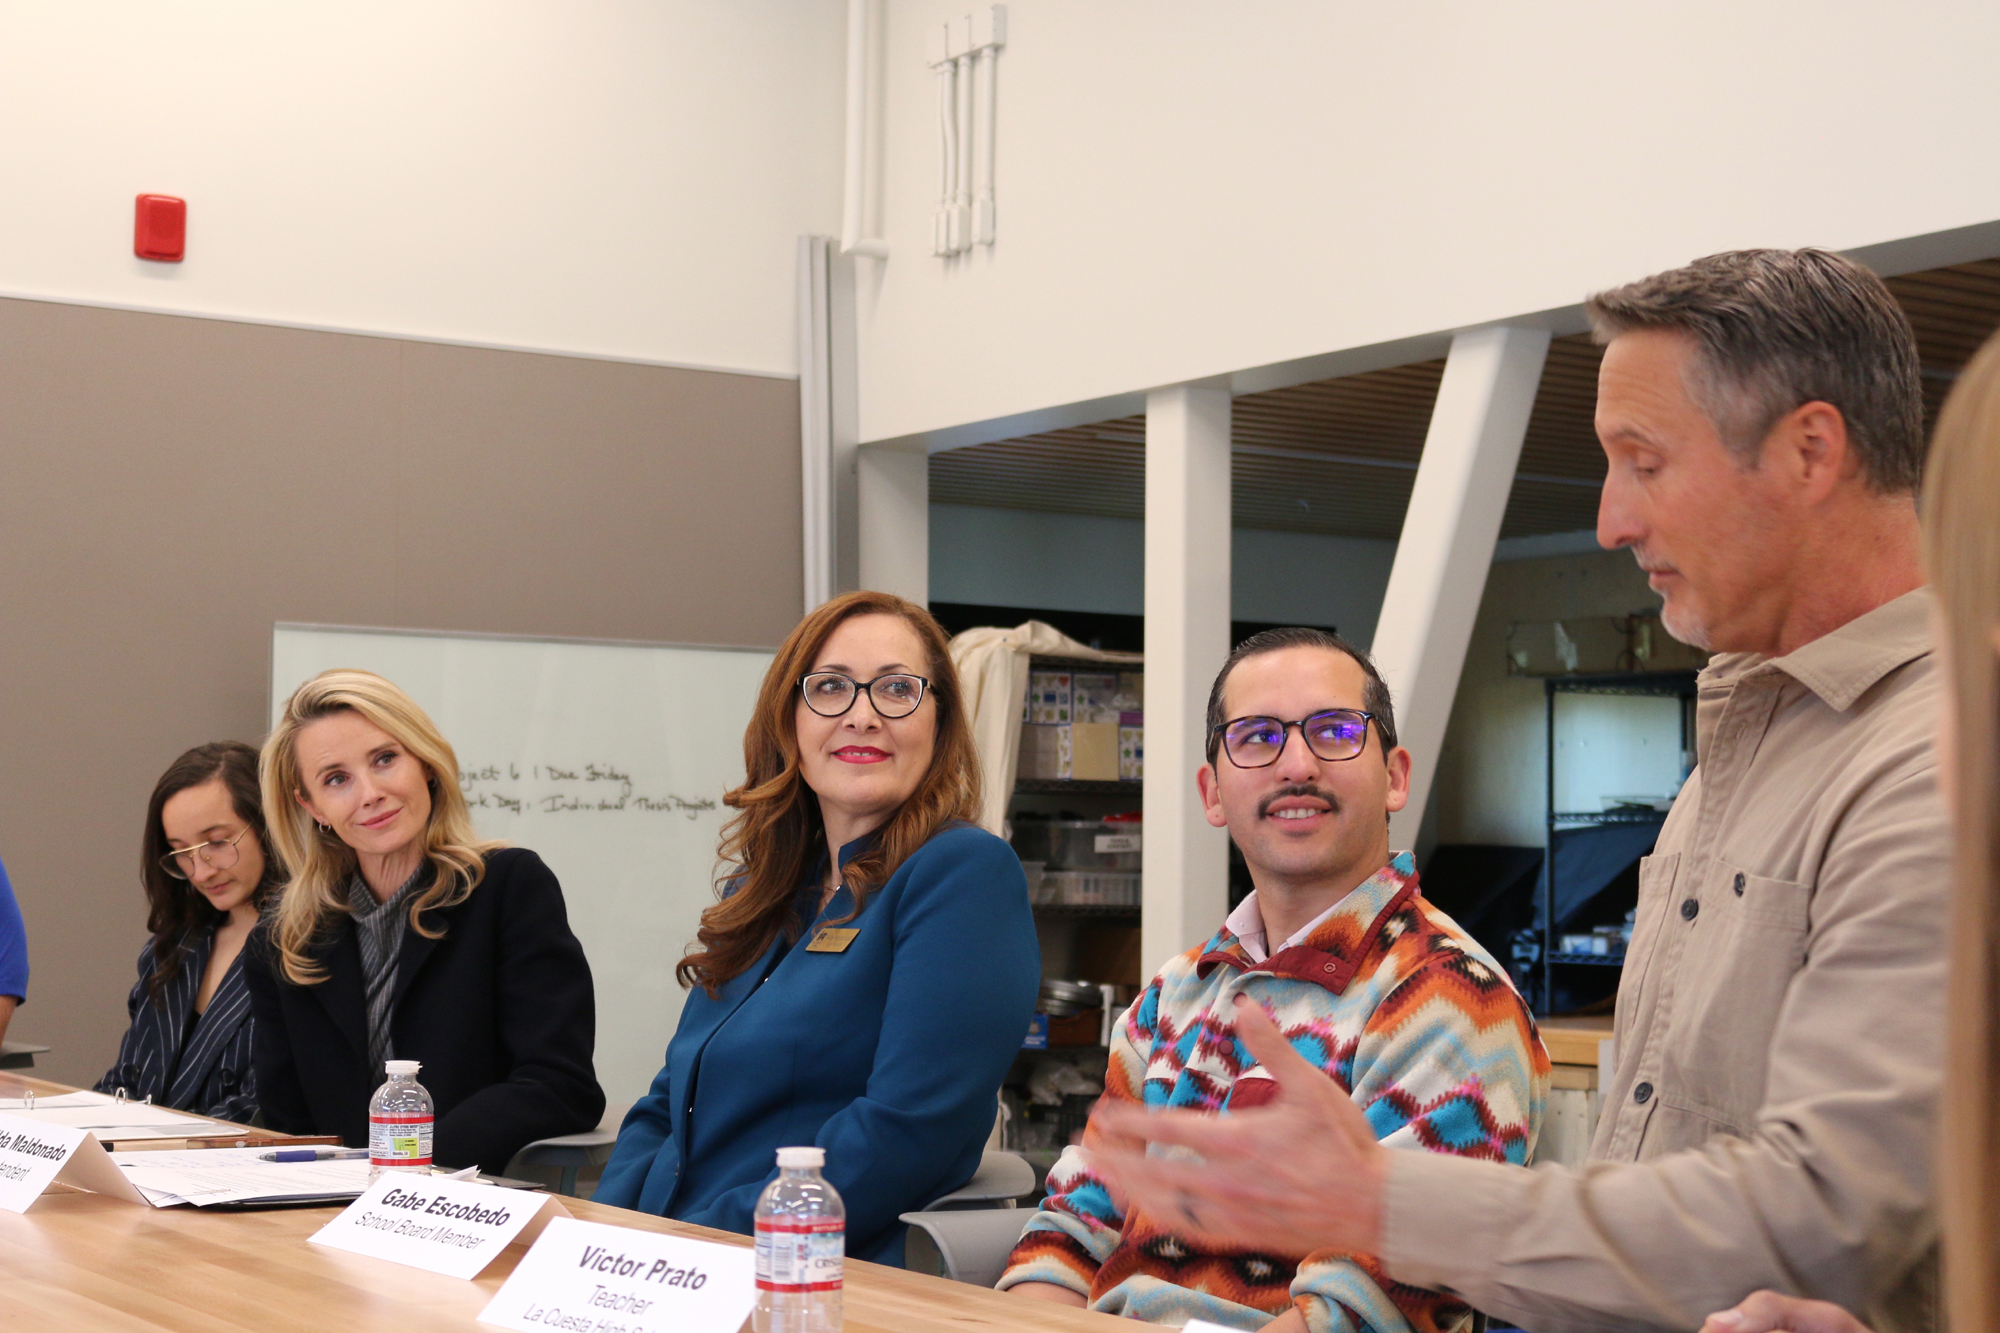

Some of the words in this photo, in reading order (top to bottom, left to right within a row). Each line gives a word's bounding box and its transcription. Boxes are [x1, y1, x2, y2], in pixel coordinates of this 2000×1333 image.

[545, 765, 579, 780] Due
[585, 763, 632, 798] Friday
[540, 794, 626, 813] Individual
[633, 797, 671, 812] Thesis
[8, 1134, 67, 1161] Maldonado
[381, 1188, 426, 1212] Gabe
[424, 1195, 511, 1227] Escobedo
[355, 1211, 397, 1230] School
[394, 1219, 435, 1240] Board
[430, 1226, 486, 1250] Member
[578, 1245, 646, 1278] Victor
[645, 1259, 708, 1291] Prato
[587, 1285, 654, 1316] Teacher
[523, 1303, 544, 1322] La
[543, 1308, 593, 1333] Cuesta
